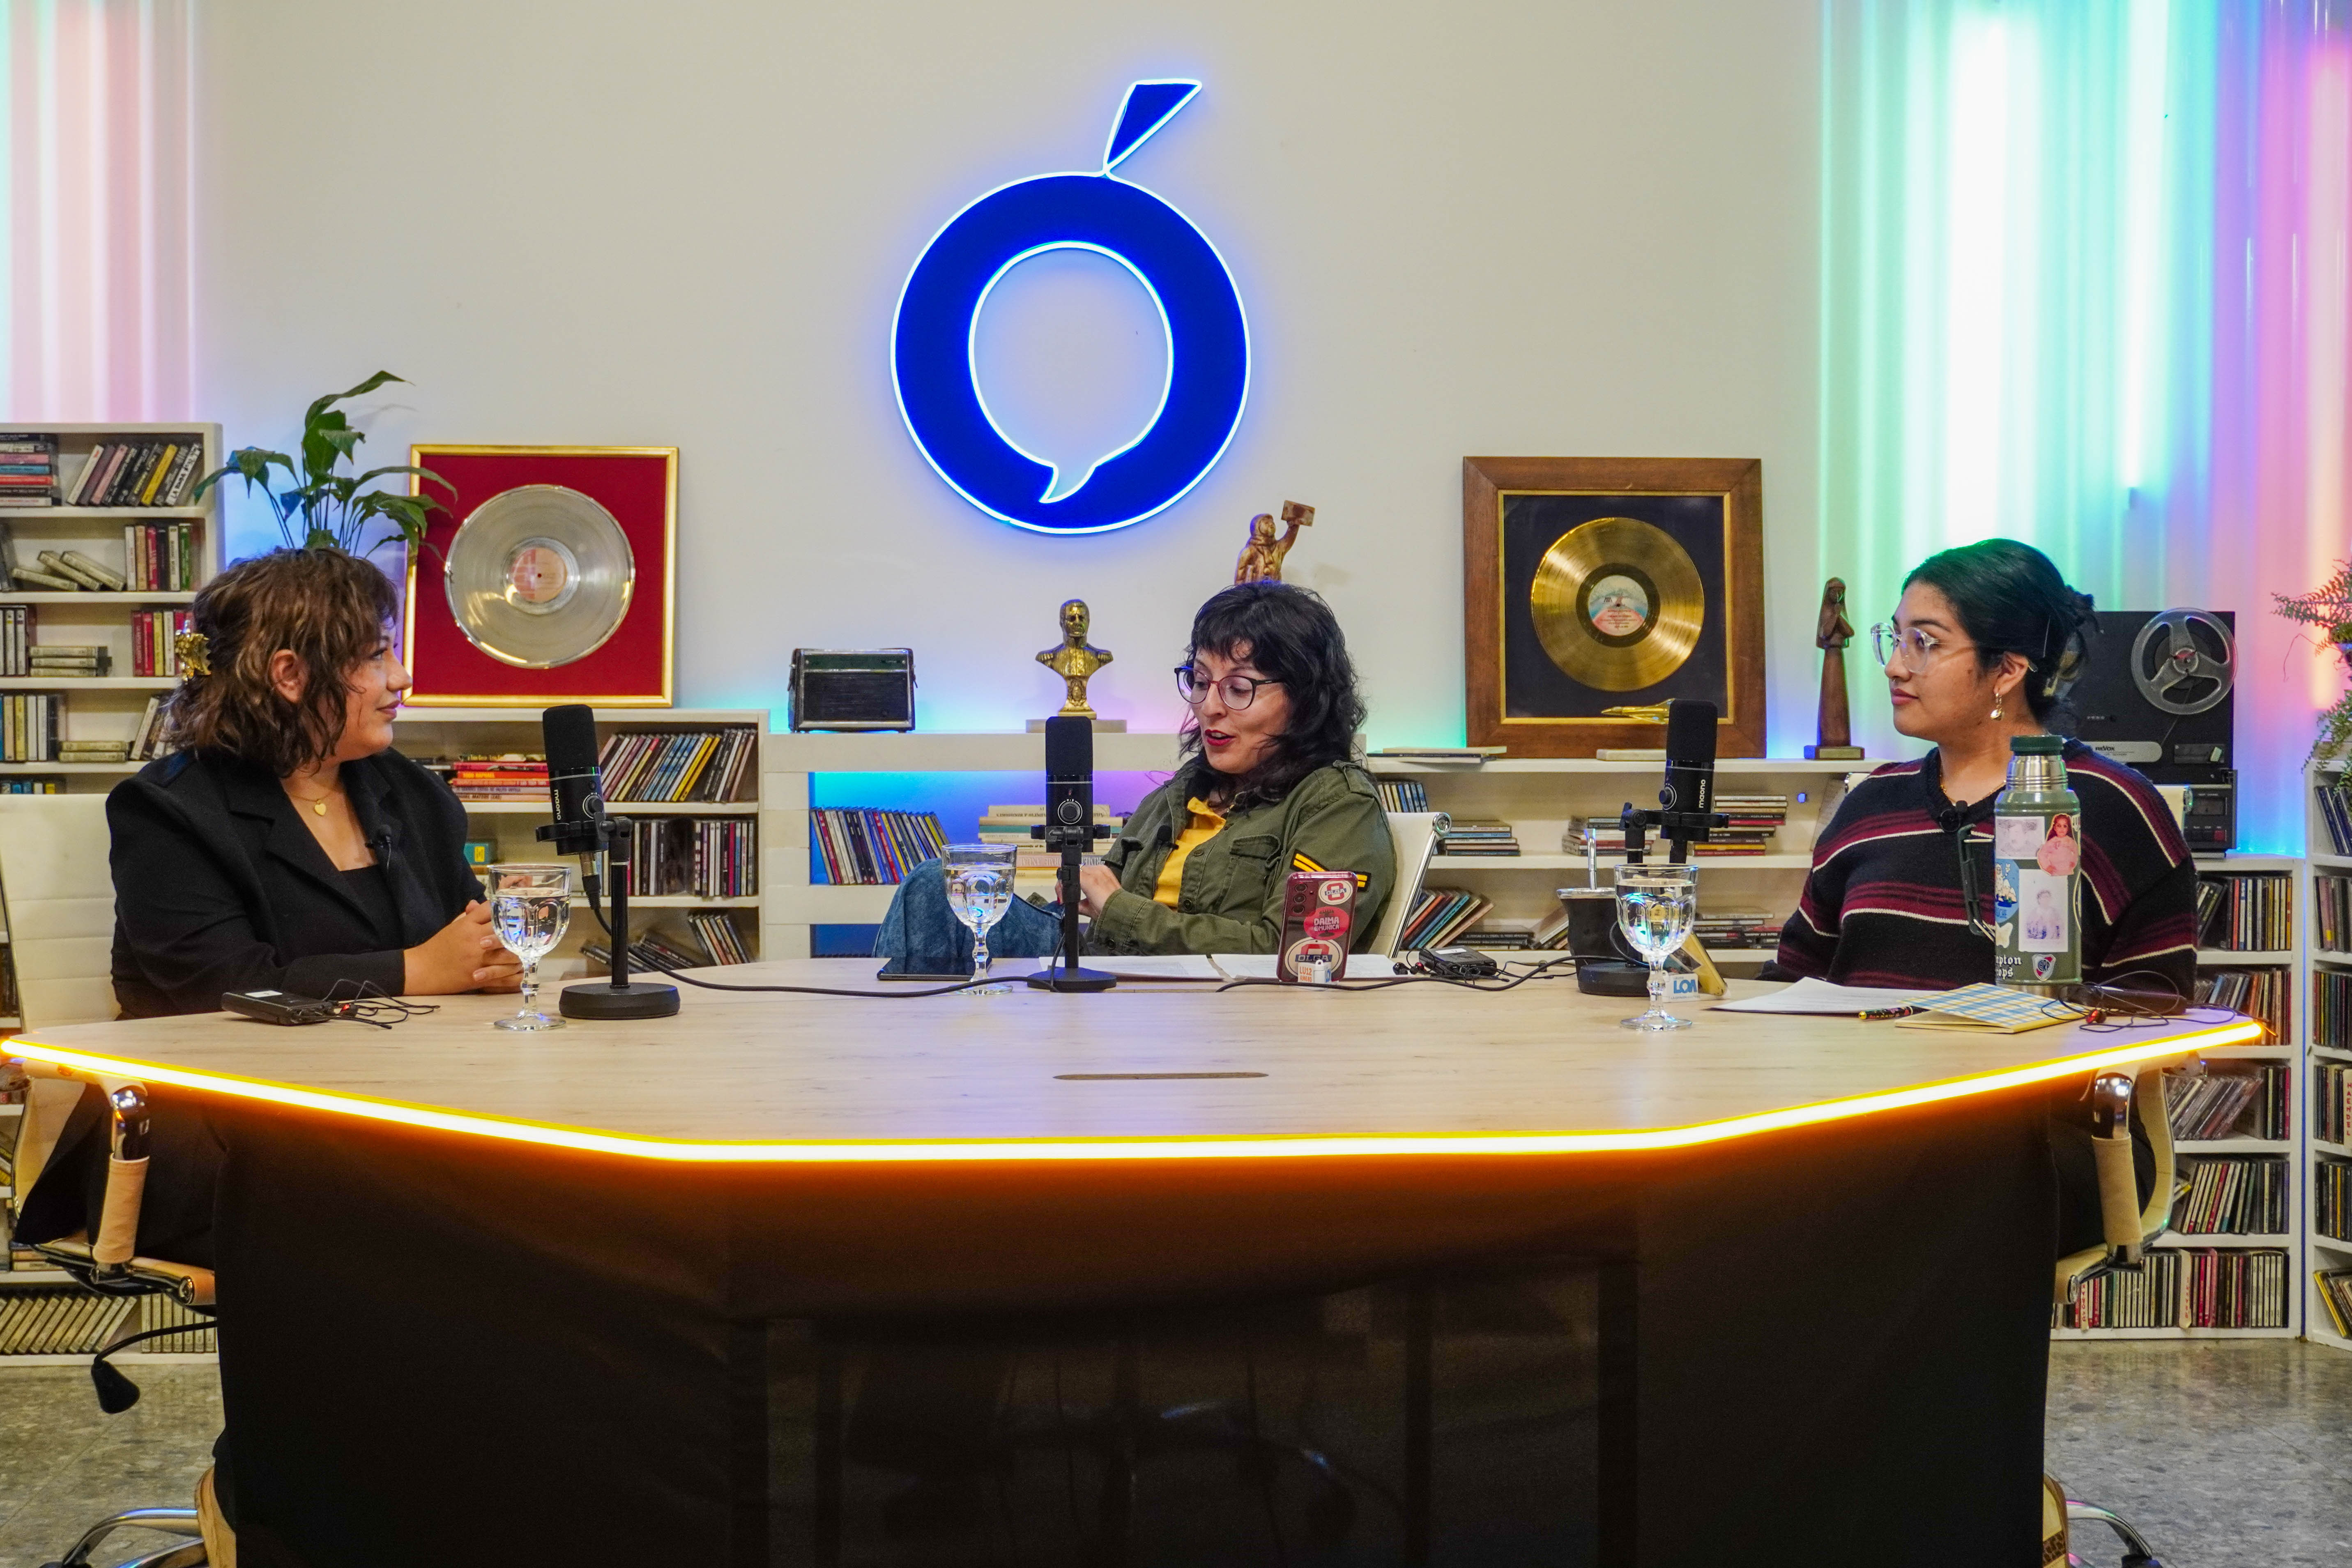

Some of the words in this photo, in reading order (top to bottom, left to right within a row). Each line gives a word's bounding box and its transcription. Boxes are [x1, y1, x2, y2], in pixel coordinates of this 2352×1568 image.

[1314, 916, 1339, 926] DALMA
[1300, 966, 1312, 976] LU12
[1673, 979, 1697, 994] LOA
